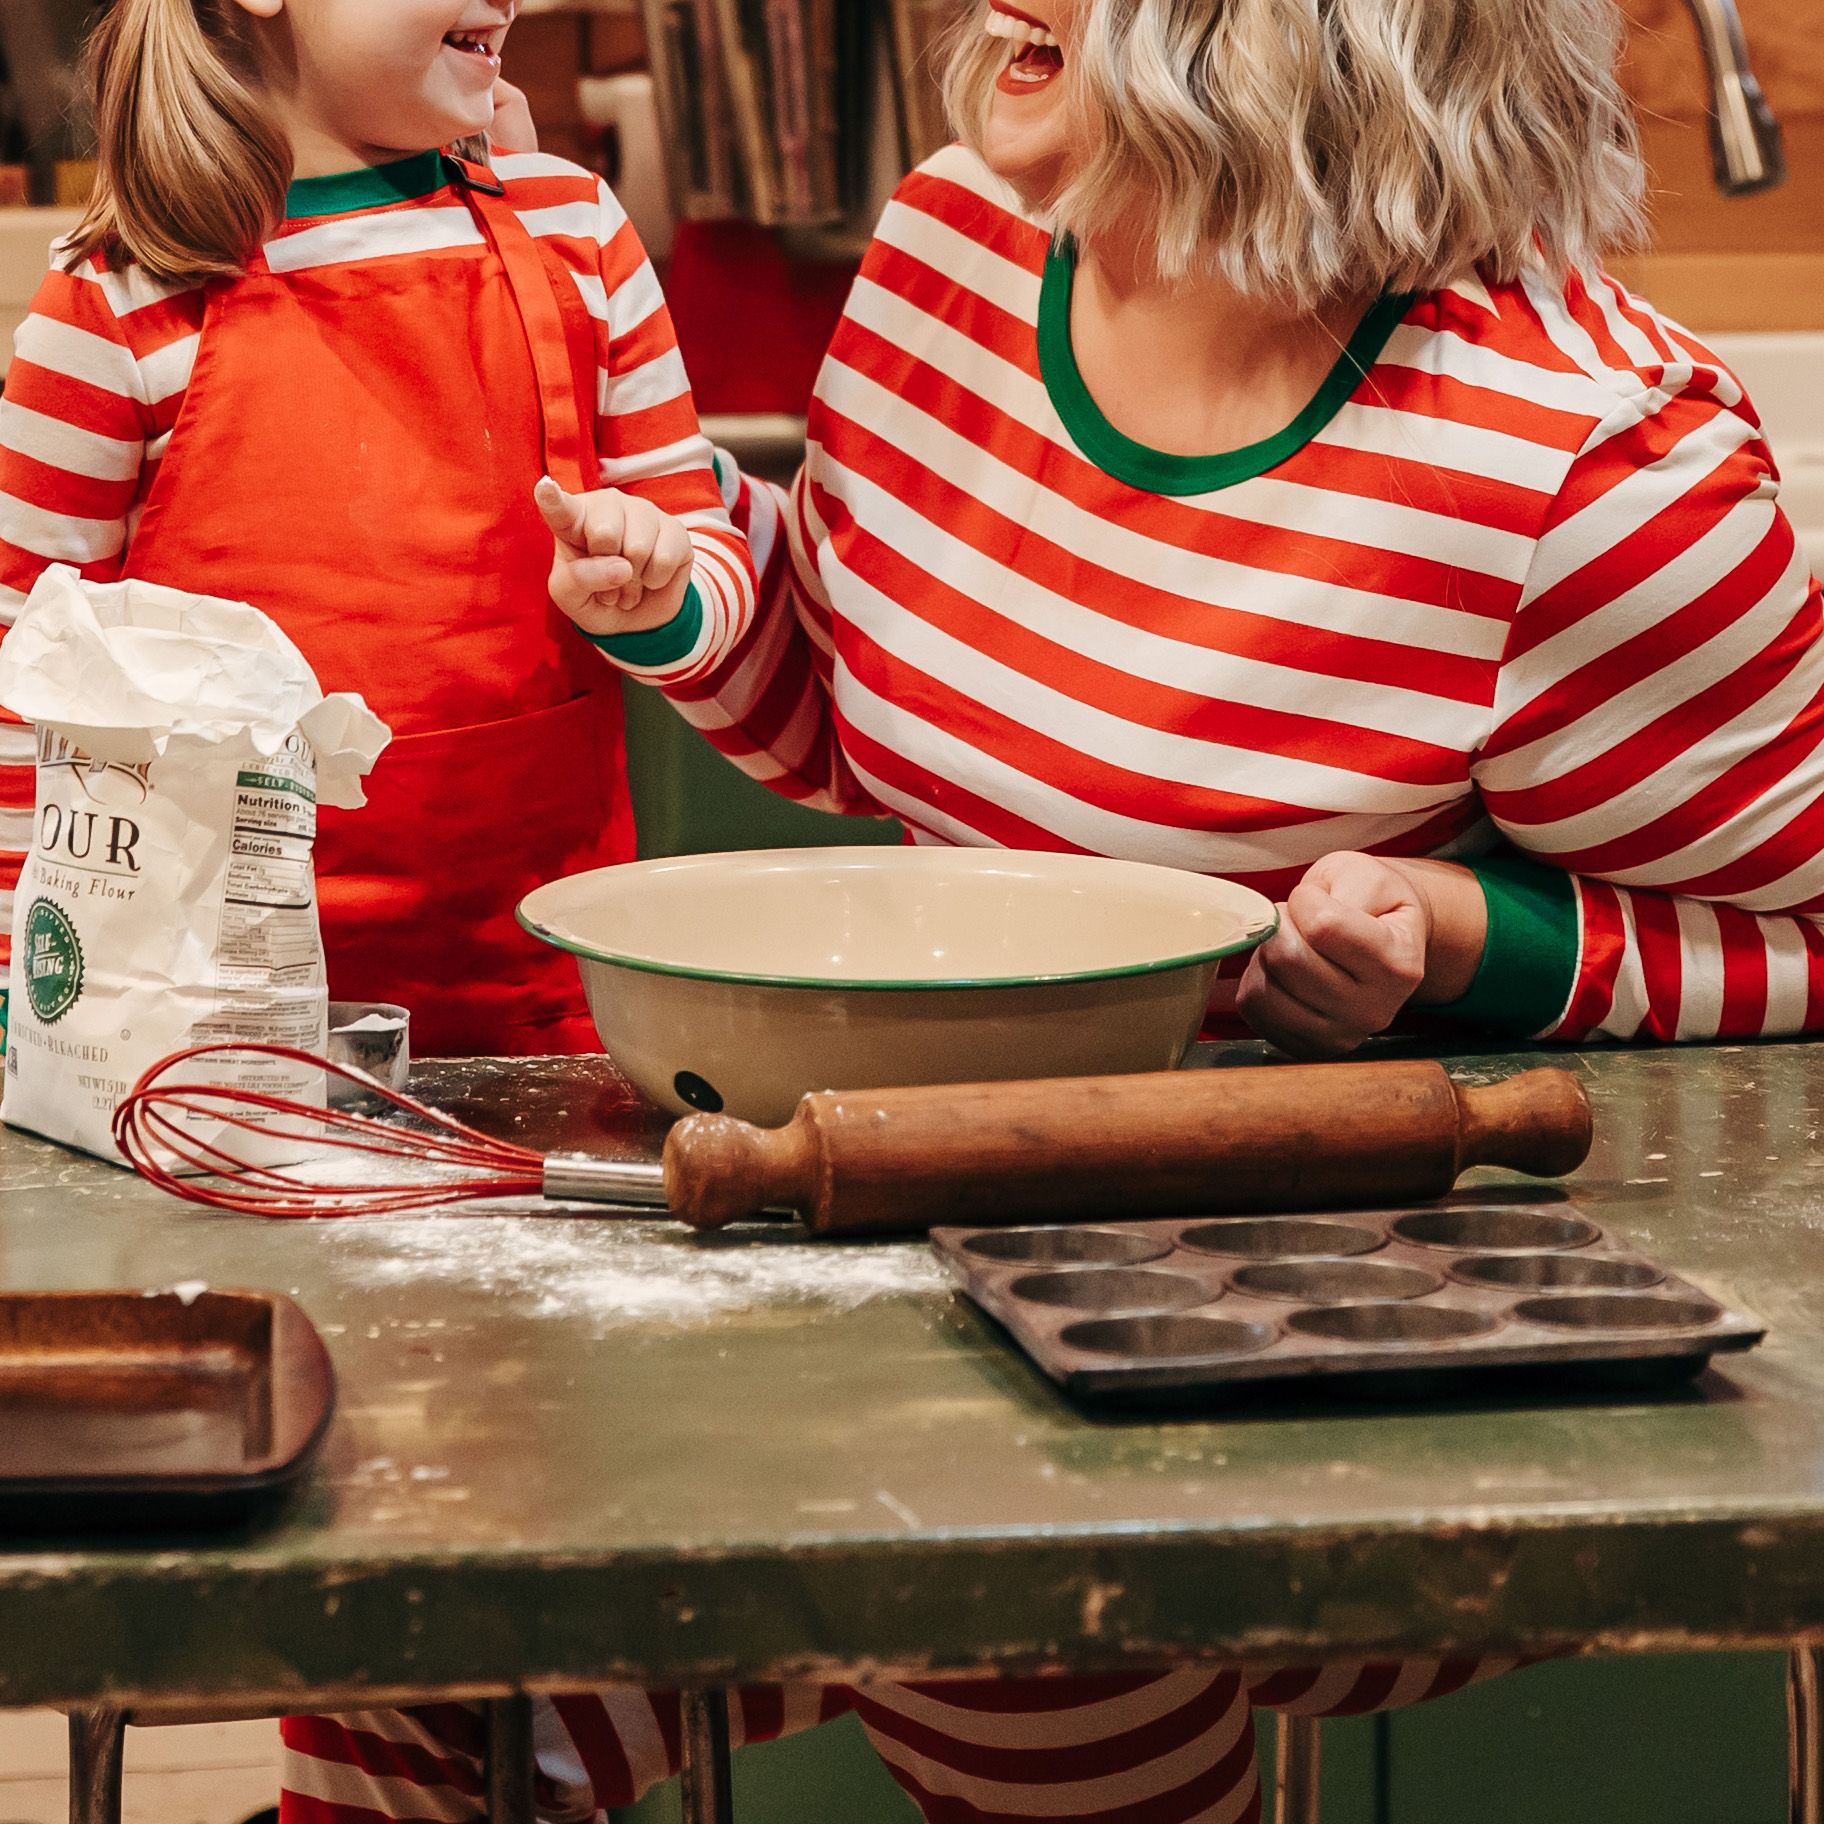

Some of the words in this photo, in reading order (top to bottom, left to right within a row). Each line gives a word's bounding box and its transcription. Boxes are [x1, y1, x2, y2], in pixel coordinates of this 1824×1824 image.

[237, 794, 300, 812] Nutrition
[232, 838, 282, 855] Calories
[39, 866, 80, 898] Baking
[88, 878, 136, 901] Flour
[47, 1035, 109, 1063] BLEACHED
